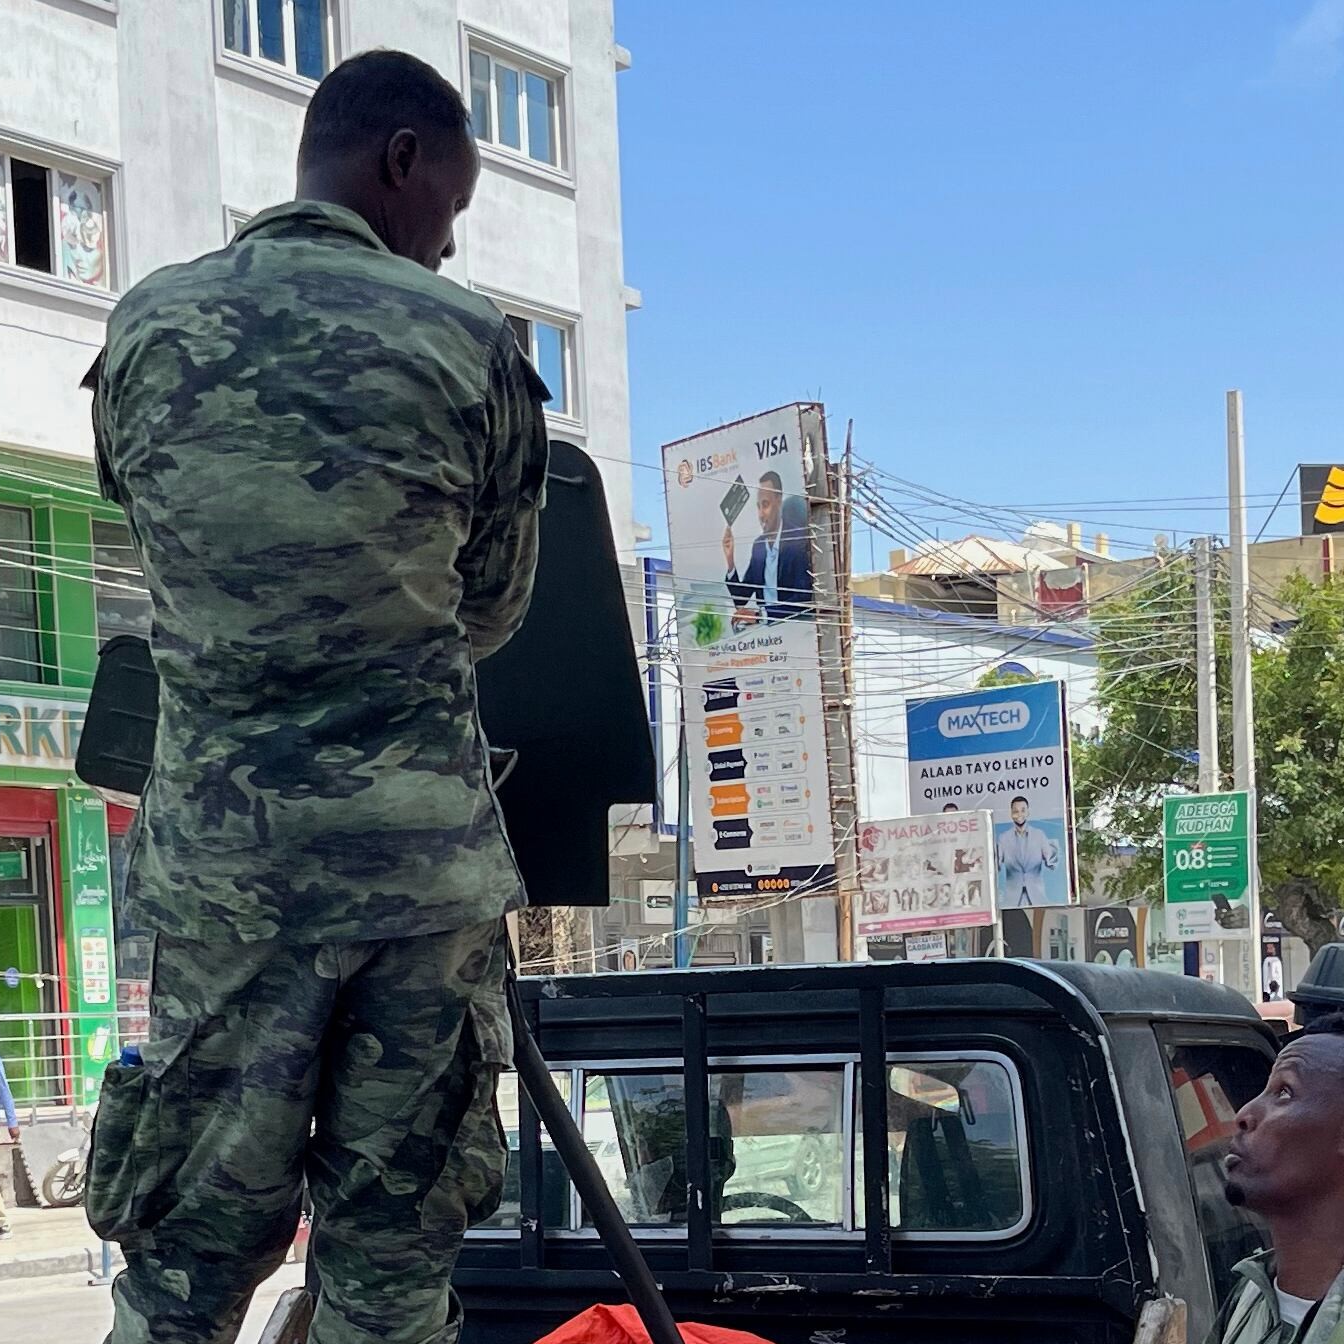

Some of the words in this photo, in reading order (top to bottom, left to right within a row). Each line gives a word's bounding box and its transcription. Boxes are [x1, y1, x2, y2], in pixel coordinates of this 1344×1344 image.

[755, 433, 789, 460] VISA
[947, 705, 1021, 733] MAXTECH
[920, 765, 963, 780] ALAAB
[966, 760, 1002, 775] TAYO
[1006, 757, 1028, 771] LEH
[1031, 754, 1054, 768] IYO
[924, 785, 962, 800] QIIMO
[966, 782, 984, 795] KU
[987, 776, 1049, 794] QANCIYO
[1175, 801, 1238, 819] ADEEGGA
[887, 825, 933, 841] MARIA
[936, 818, 979, 835] ROSE
[1176, 817, 1234, 834] KUDHAN
